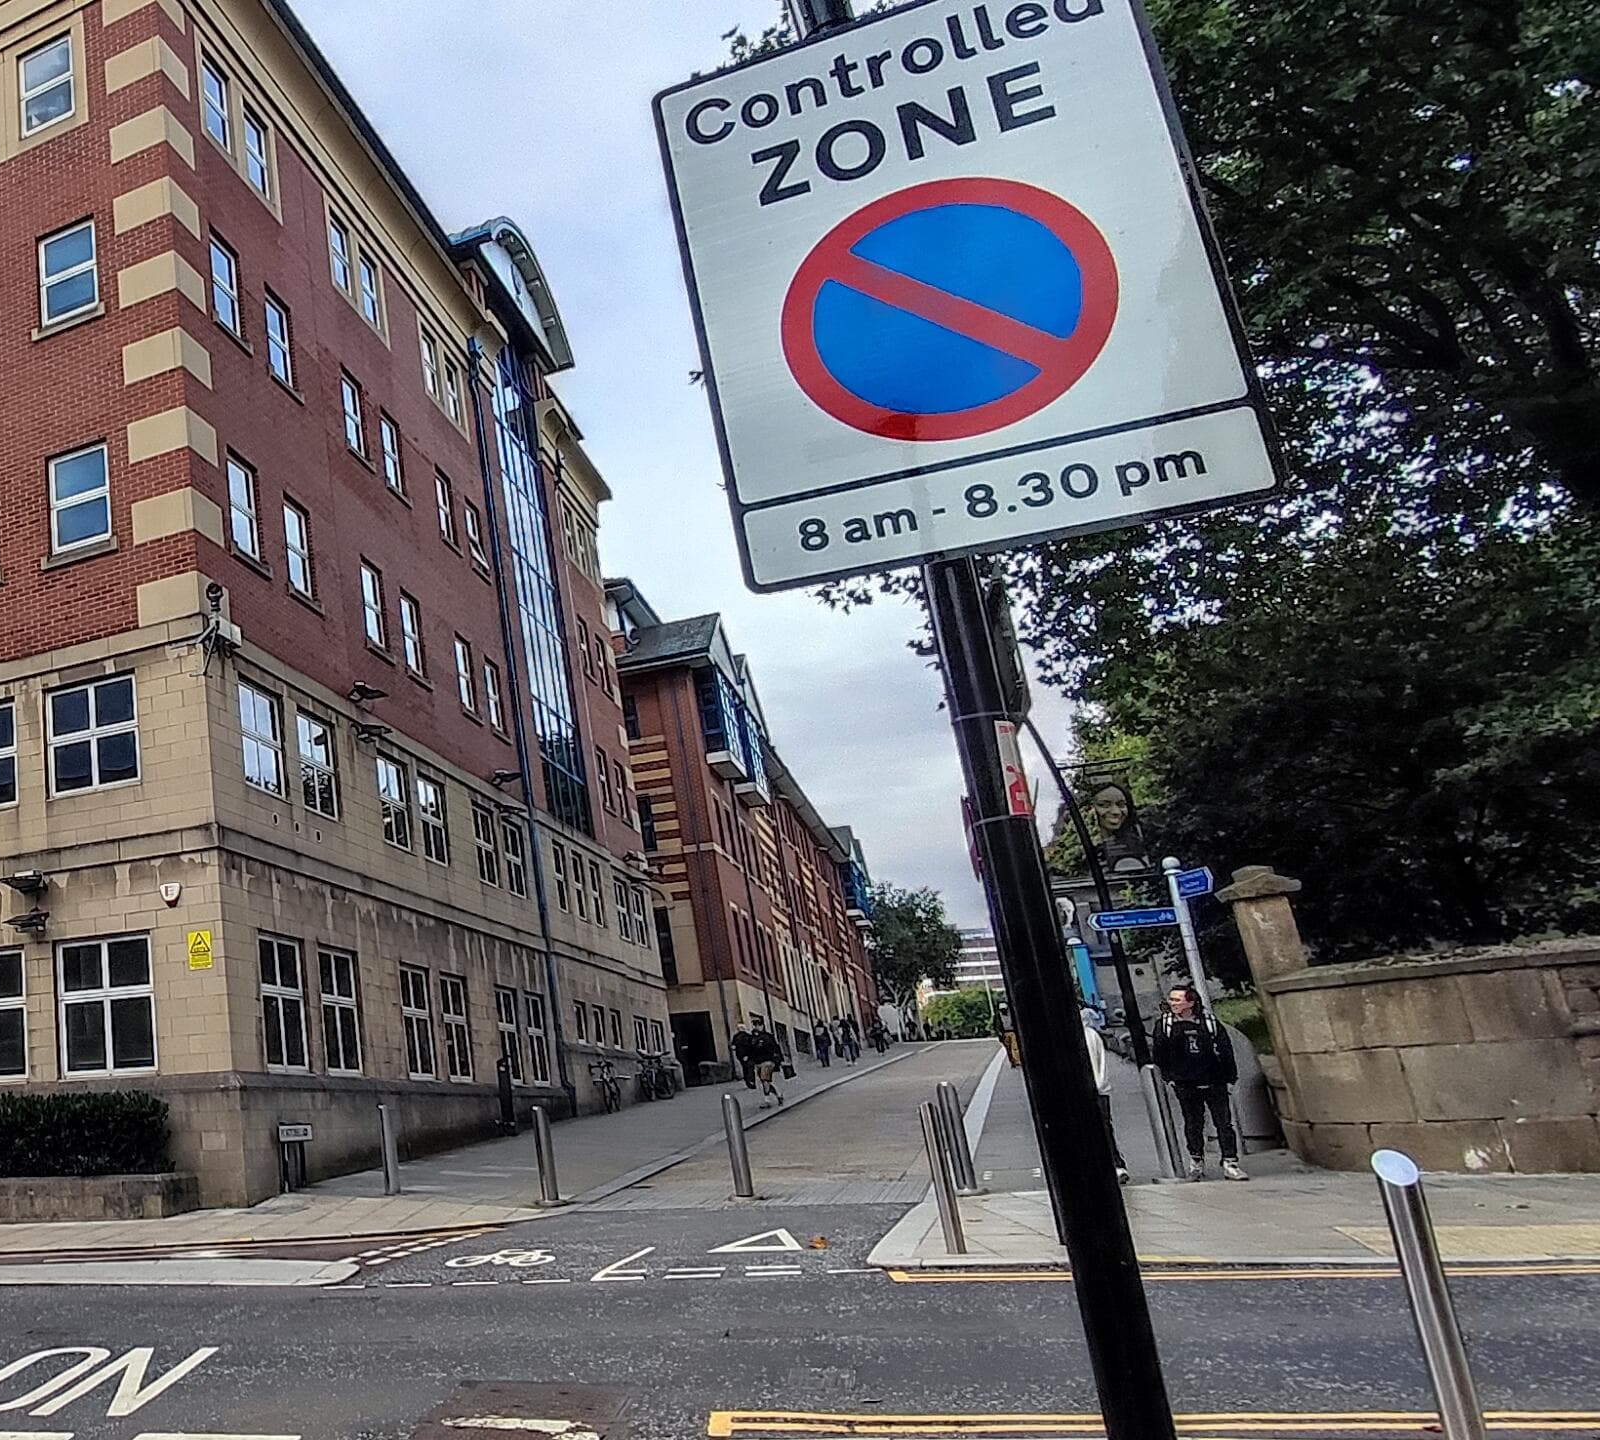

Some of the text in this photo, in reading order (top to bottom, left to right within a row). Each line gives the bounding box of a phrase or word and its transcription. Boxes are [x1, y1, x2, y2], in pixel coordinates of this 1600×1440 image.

[685, 0, 1105, 145] Controlled
[751, 61, 1057, 207] ZONE
[799, 516, 830, 552] 8
[844, 503, 919, 544] am
[963, 462, 1098, 519] 8.30
[1115, 448, 1207, 497] pm
